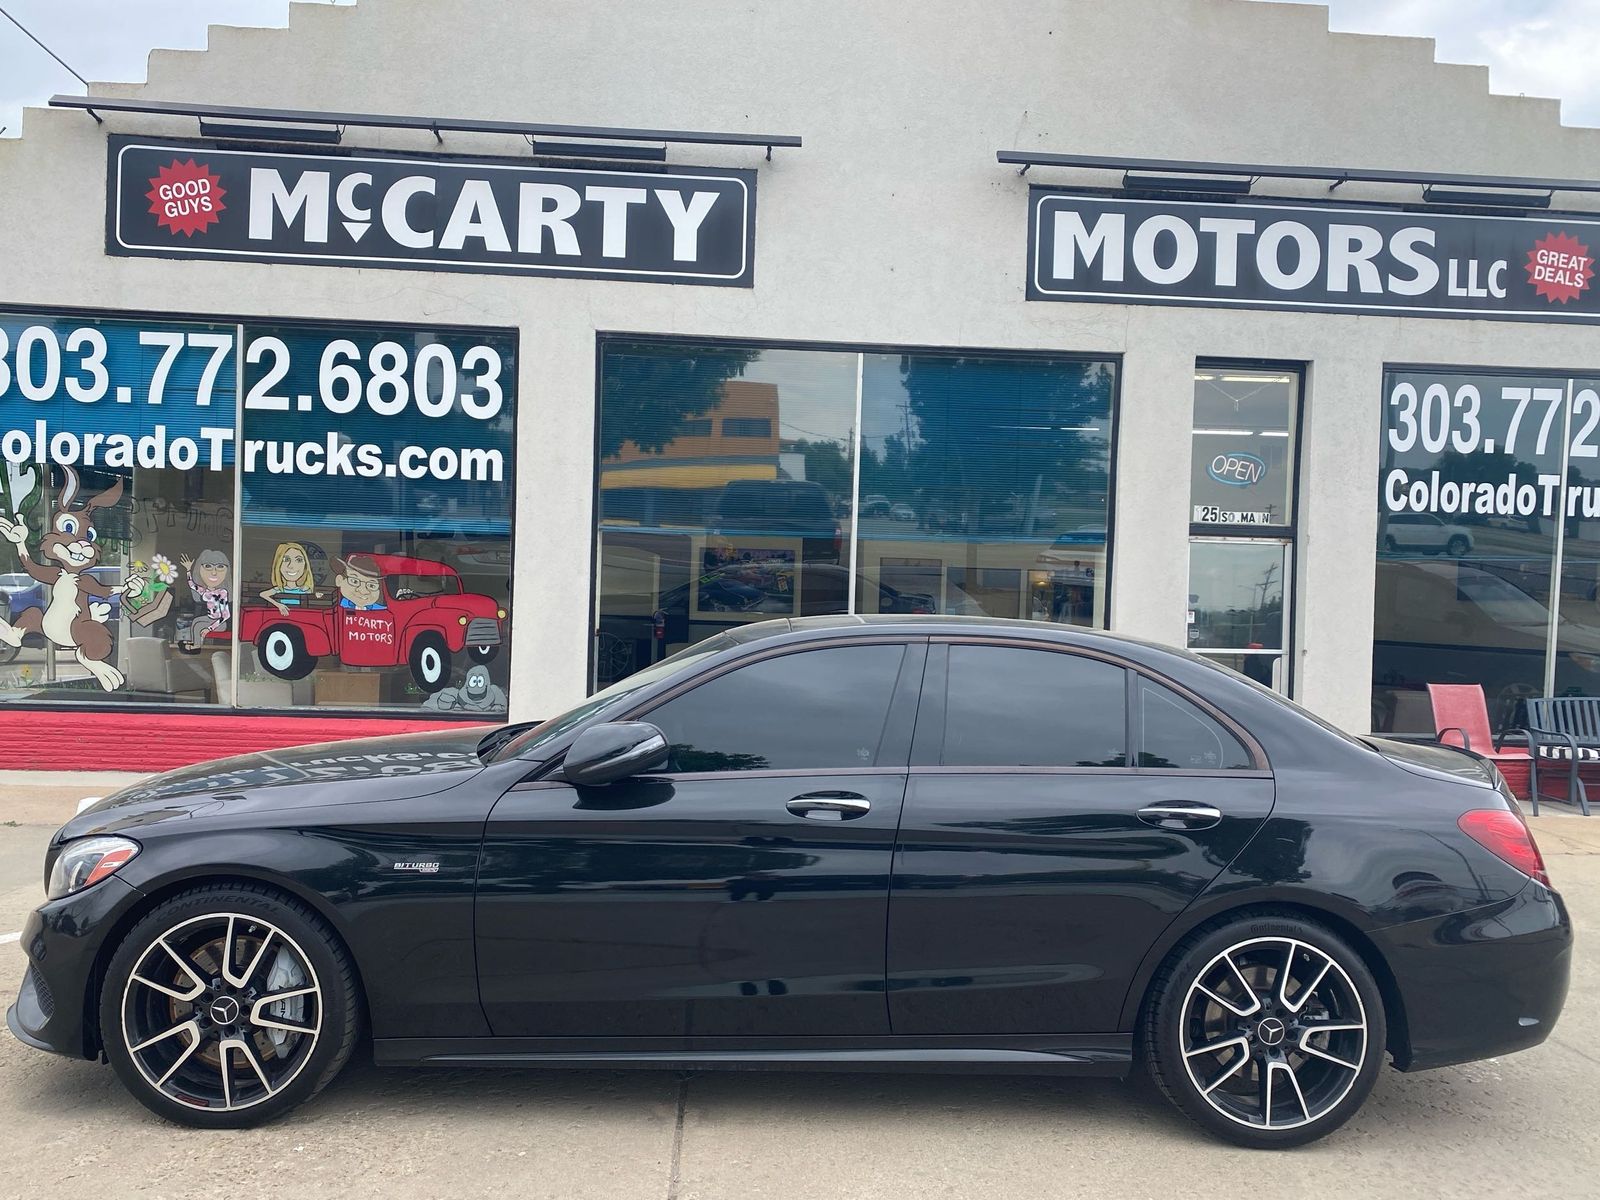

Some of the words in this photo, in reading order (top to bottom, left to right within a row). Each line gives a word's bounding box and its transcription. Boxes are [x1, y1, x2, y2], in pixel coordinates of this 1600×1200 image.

[159, 178, 211, 201] GOOD
[164, 196, 212, 217] GUYS
[1052, 210, 1440, 296] MOTORS
[1447, 258, 1508, 298] LLC
[1536, 249, 1588, 272] GREAT
[1534, 265, 1585, 288] DEALS
[0, 325, 503, 420] 03.772.6803
[1212, 455, 1262, 483] OPEN
[348, 631, 393, 645] MOTORS
[157, 893, 279, 921] CONTINENTAL
